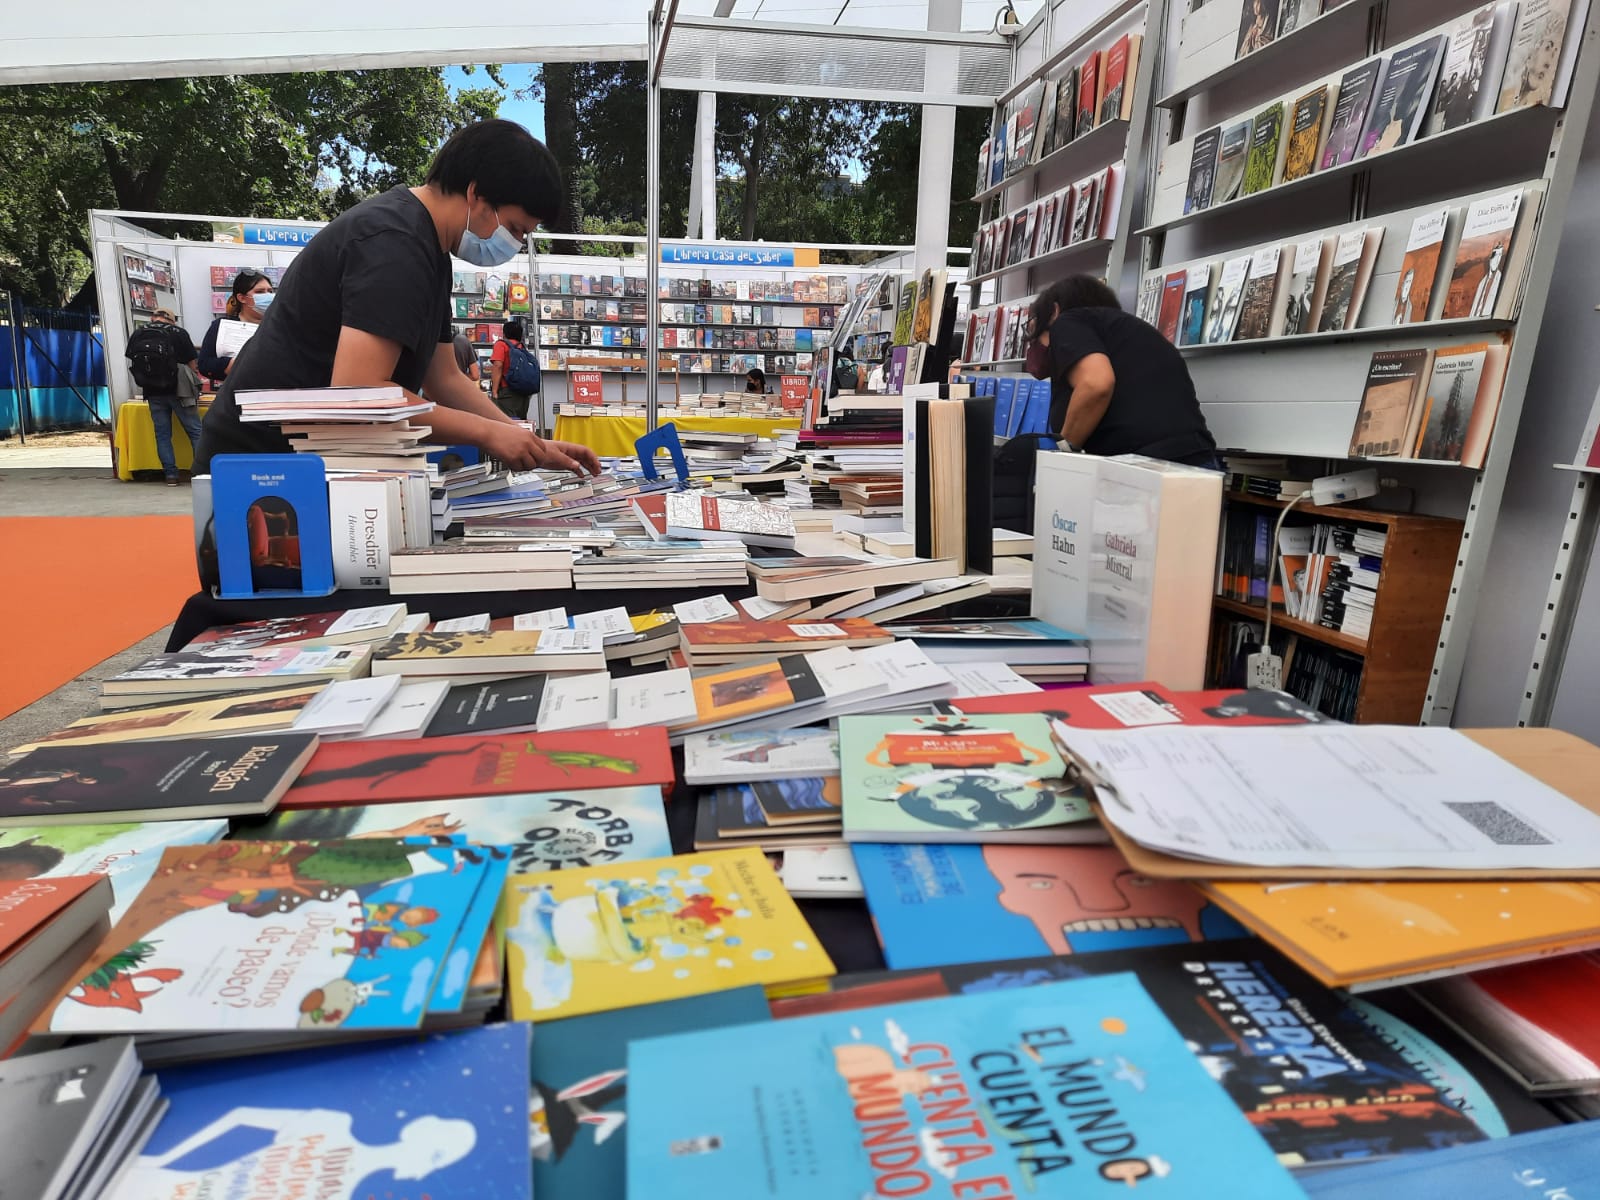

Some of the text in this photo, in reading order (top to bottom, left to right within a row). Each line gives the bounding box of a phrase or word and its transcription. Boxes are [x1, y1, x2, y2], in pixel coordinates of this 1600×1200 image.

[712, 249, 735, 261] Casa
[754, 252, 782, 264] Saber
[574, 374, 600, 383] LIBROS
[782, 378, 806, 386] LIBROS
[364, 508, 379, 569] Dresdner
[1052, 510, 1077, 533] Óscar
[1052, 534, 1075, 556] Hahn
[1105, 531, 1136, 558] Gabriela
[1105, 554, 1133, 581] Mistral
[209, 745, 279, 792] Radrigán
[212, 926, 297, 1009] de paseo?
[253, 960, 300, 1008] vamos
[1207, 961, 1349, 1079] HEREDIA
[903, 1044, 994, 1168] CUENTA
[970, 1049, 1073, 1176] CUENTA
[1020, 1026, 1151, 1183] EL MUNDO
[847, 1072, 932, 1198] MUNDO
